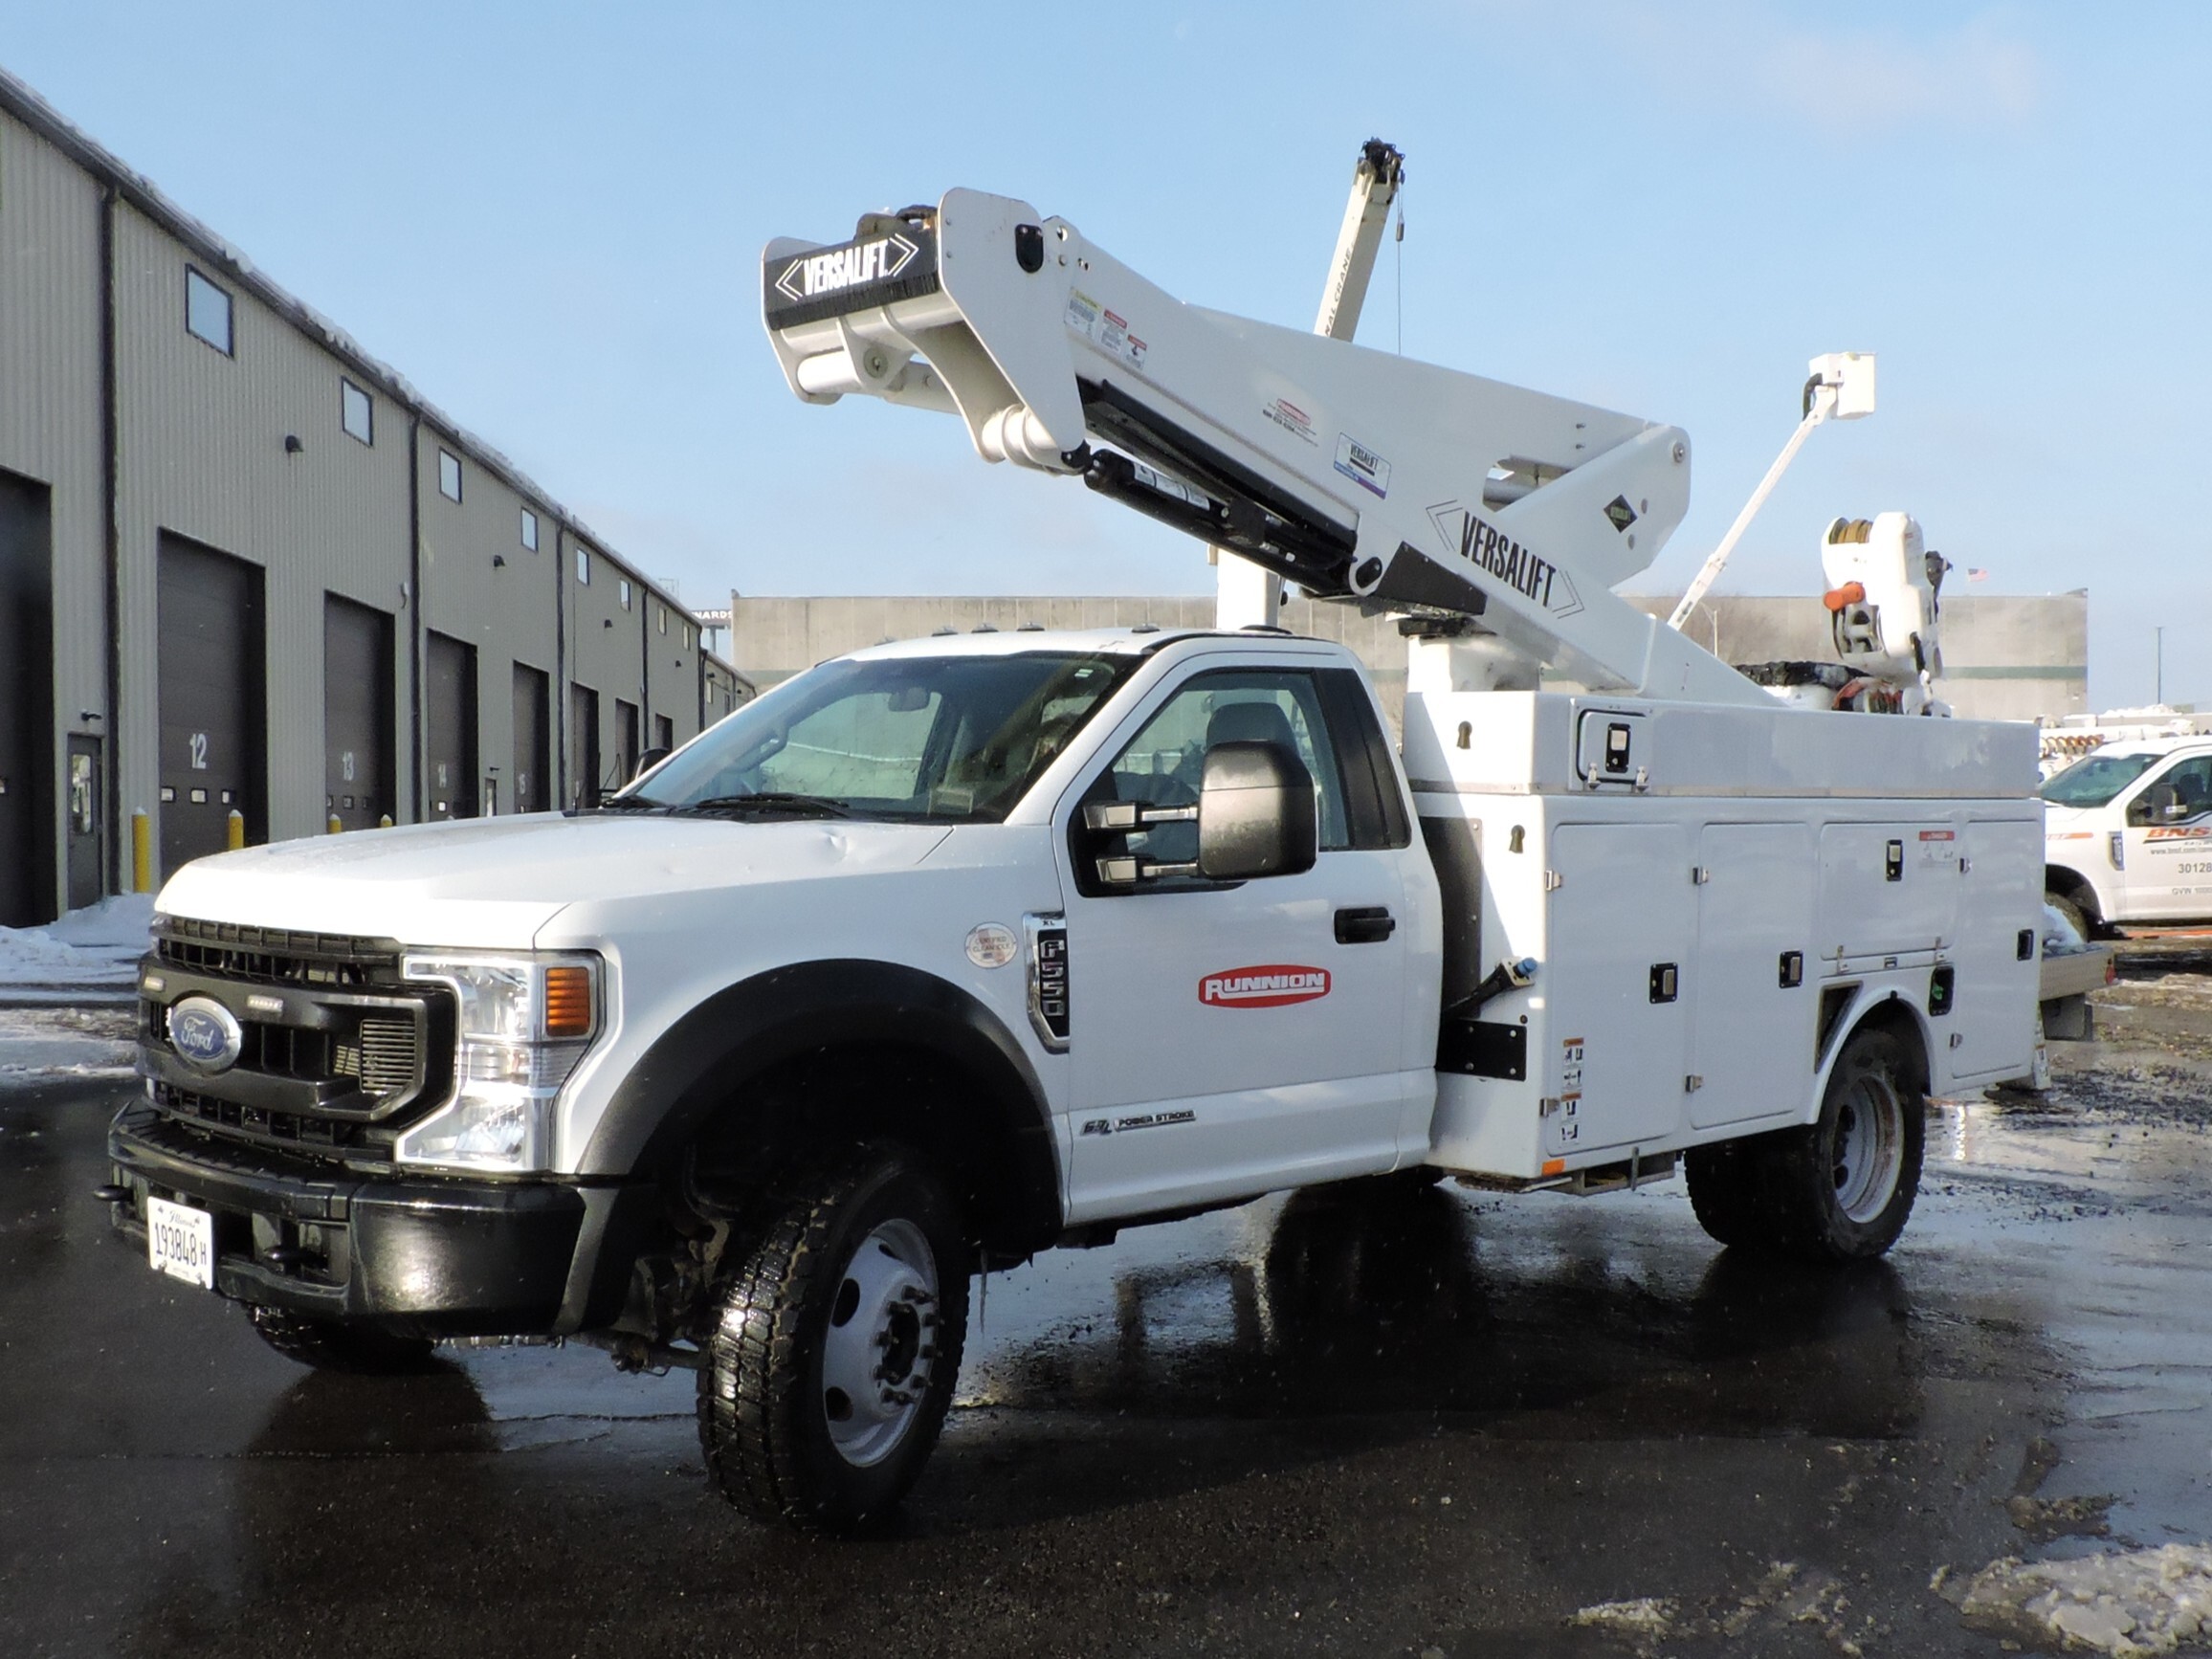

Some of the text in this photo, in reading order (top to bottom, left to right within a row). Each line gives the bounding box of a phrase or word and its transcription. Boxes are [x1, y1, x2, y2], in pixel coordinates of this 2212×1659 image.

[804, 239, 889, 296] VERSALIFT
[1334, 247, 1351, 302] CRANE
[1460, 510, 1557, 608] VERSALIFT
[189, 733, 208, 769] 12
[342, 751, 355, 782] 13
[2147, 827, 2212, 838] BNS
[1206, 972, 1325, 1001] RUNNION
[181, 1016, 214, 1051] Ford
[1118, 1115, 1154, 1127] POWER
[1156, 1110, 1195, 1122] STROKE
